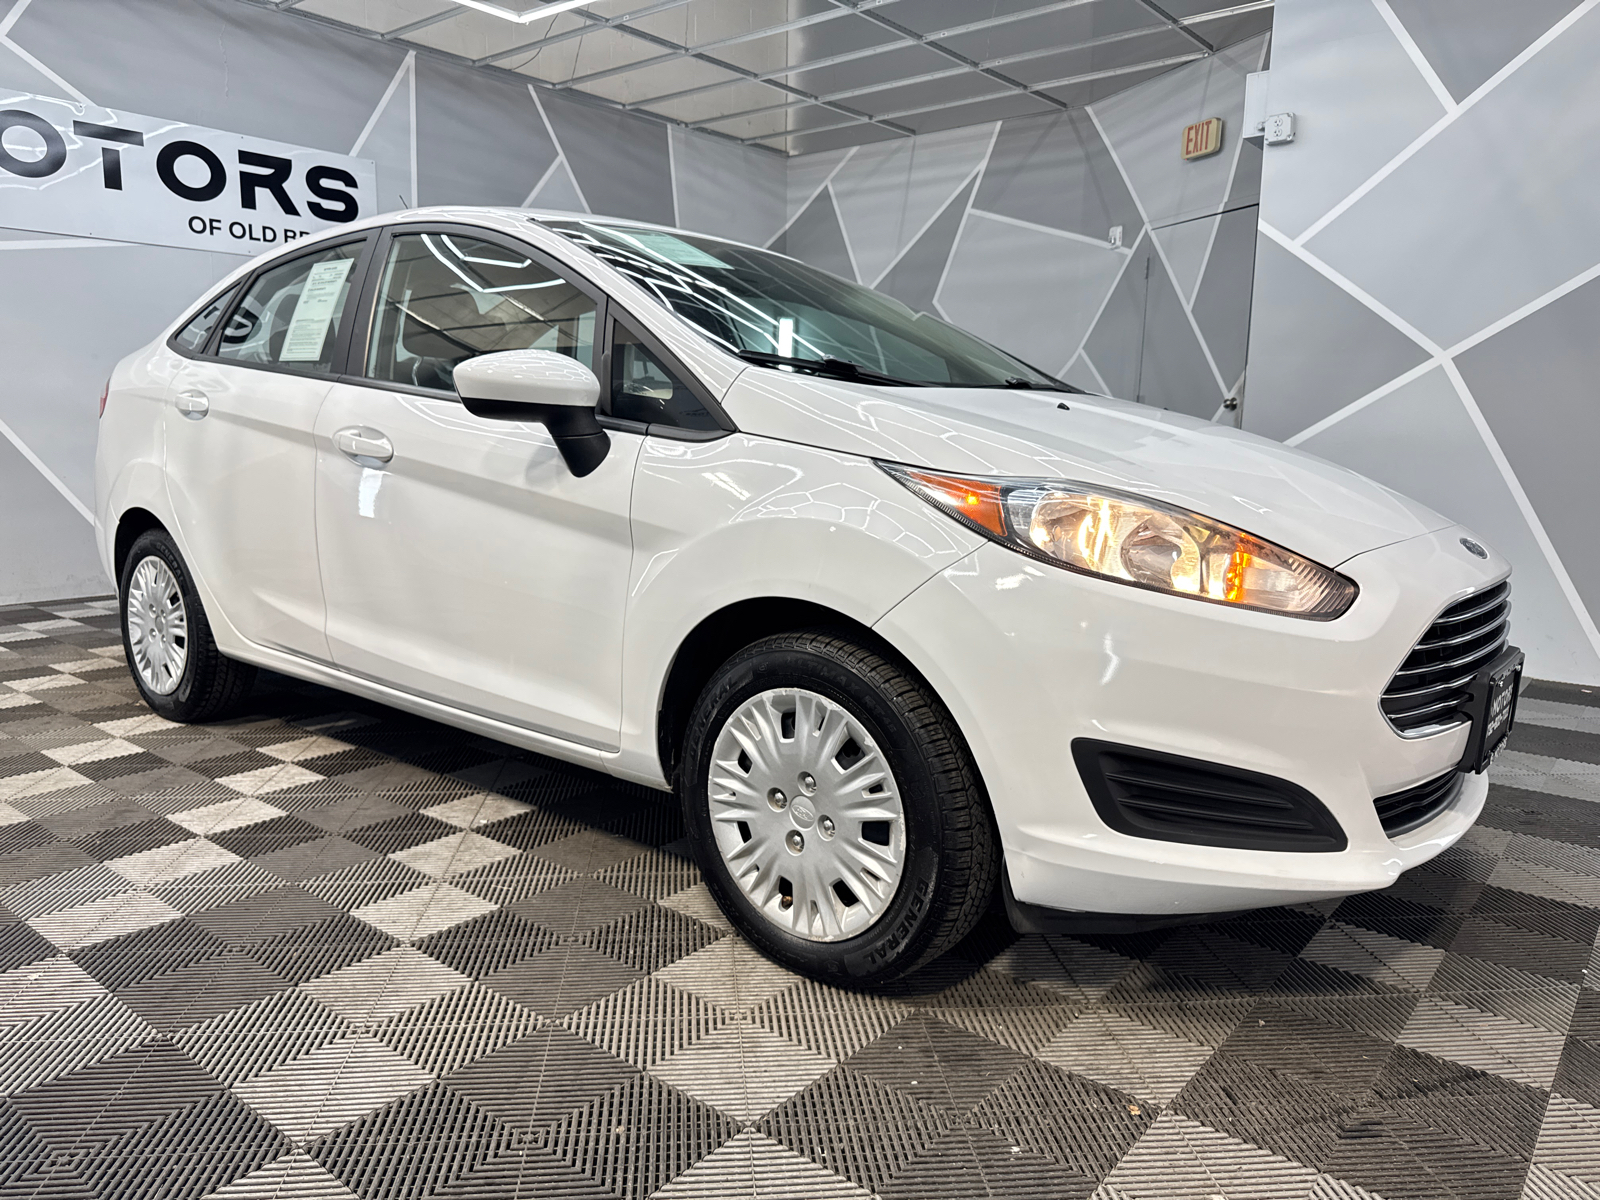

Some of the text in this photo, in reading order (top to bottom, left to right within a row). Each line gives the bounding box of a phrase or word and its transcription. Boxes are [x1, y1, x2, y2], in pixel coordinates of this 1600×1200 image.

[1186, 120, 1212, 155] EXIT
[188, 215, 221, 236] OF
[229, 221, 277, 243] OLD
[863, 877, 929, 964] GENERAL
